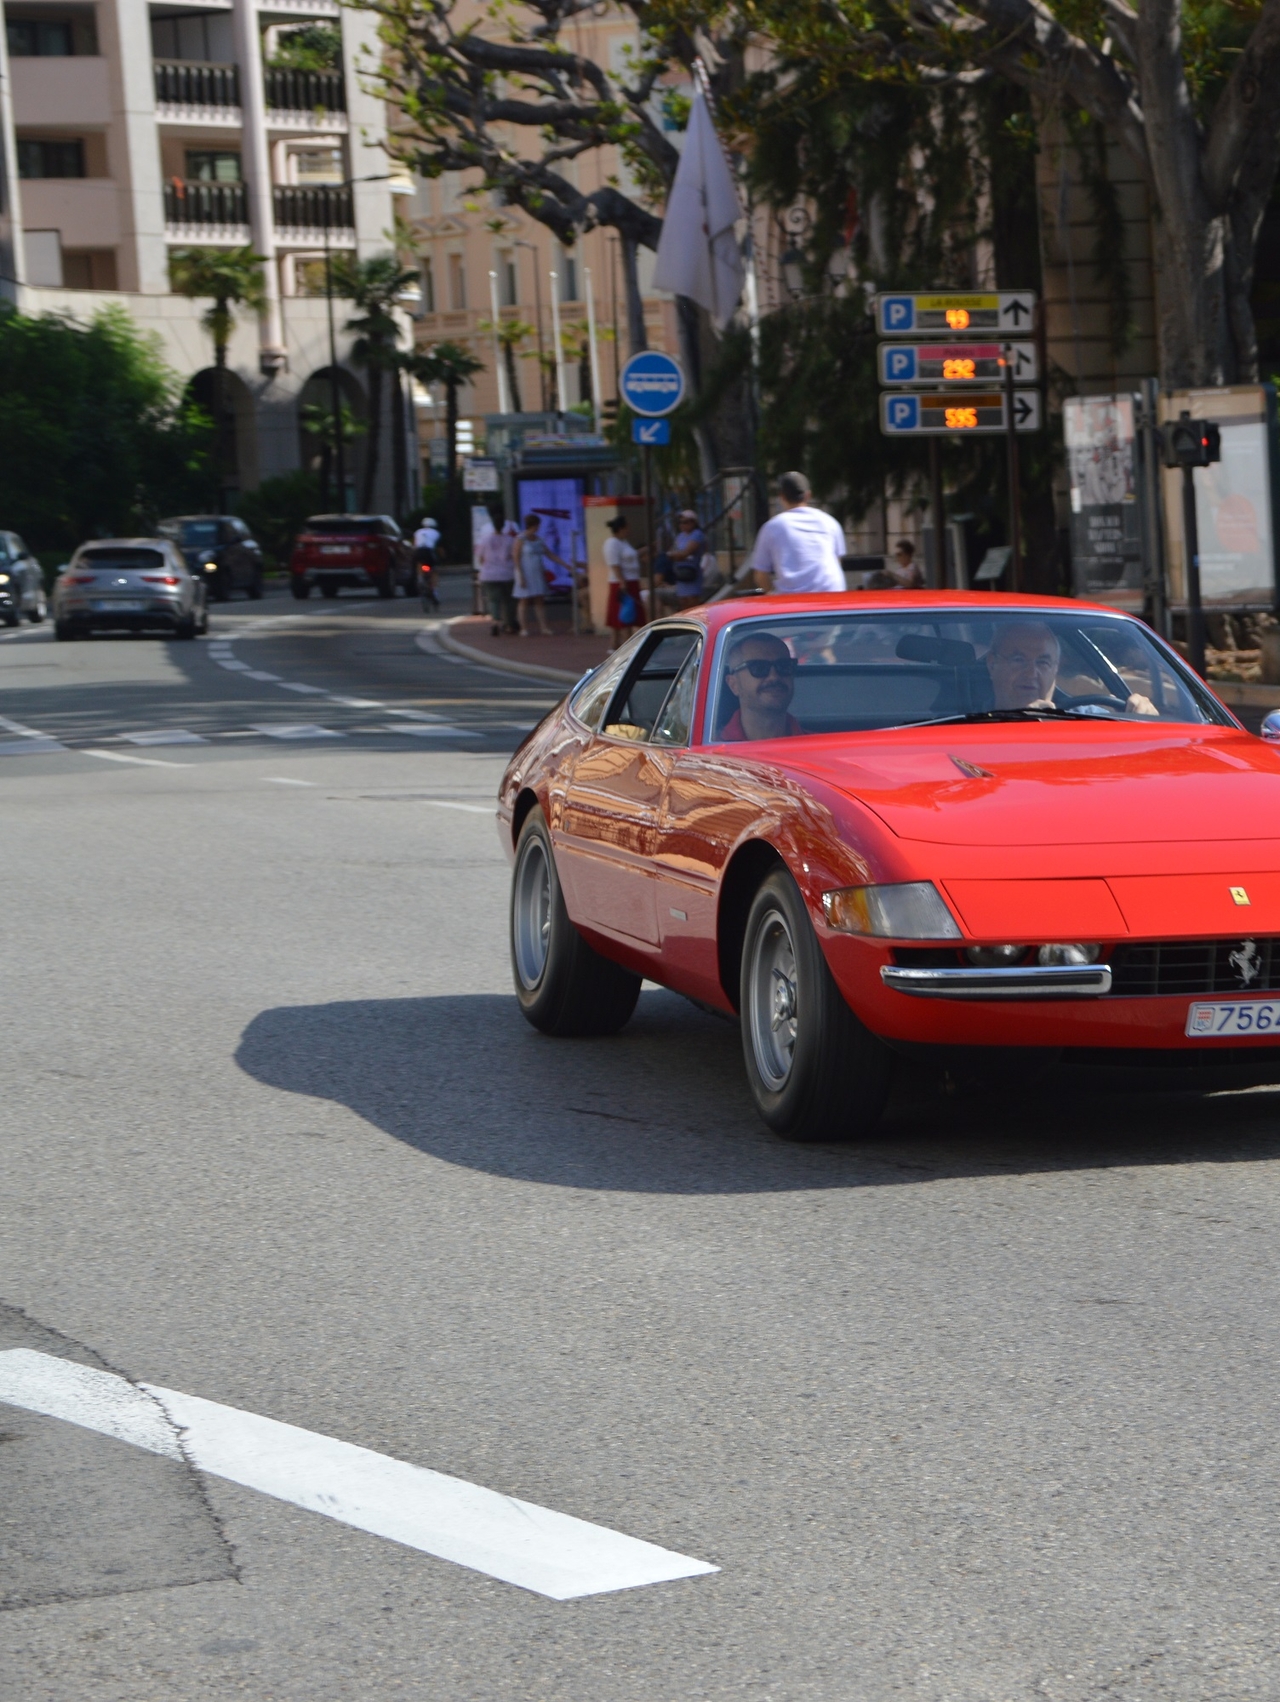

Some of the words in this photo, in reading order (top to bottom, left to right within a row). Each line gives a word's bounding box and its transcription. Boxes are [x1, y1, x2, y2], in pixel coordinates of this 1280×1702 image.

[890, 303, 906, 325] P
[892, 353, 908, 374] P
[894, 402, 910, 424] P
